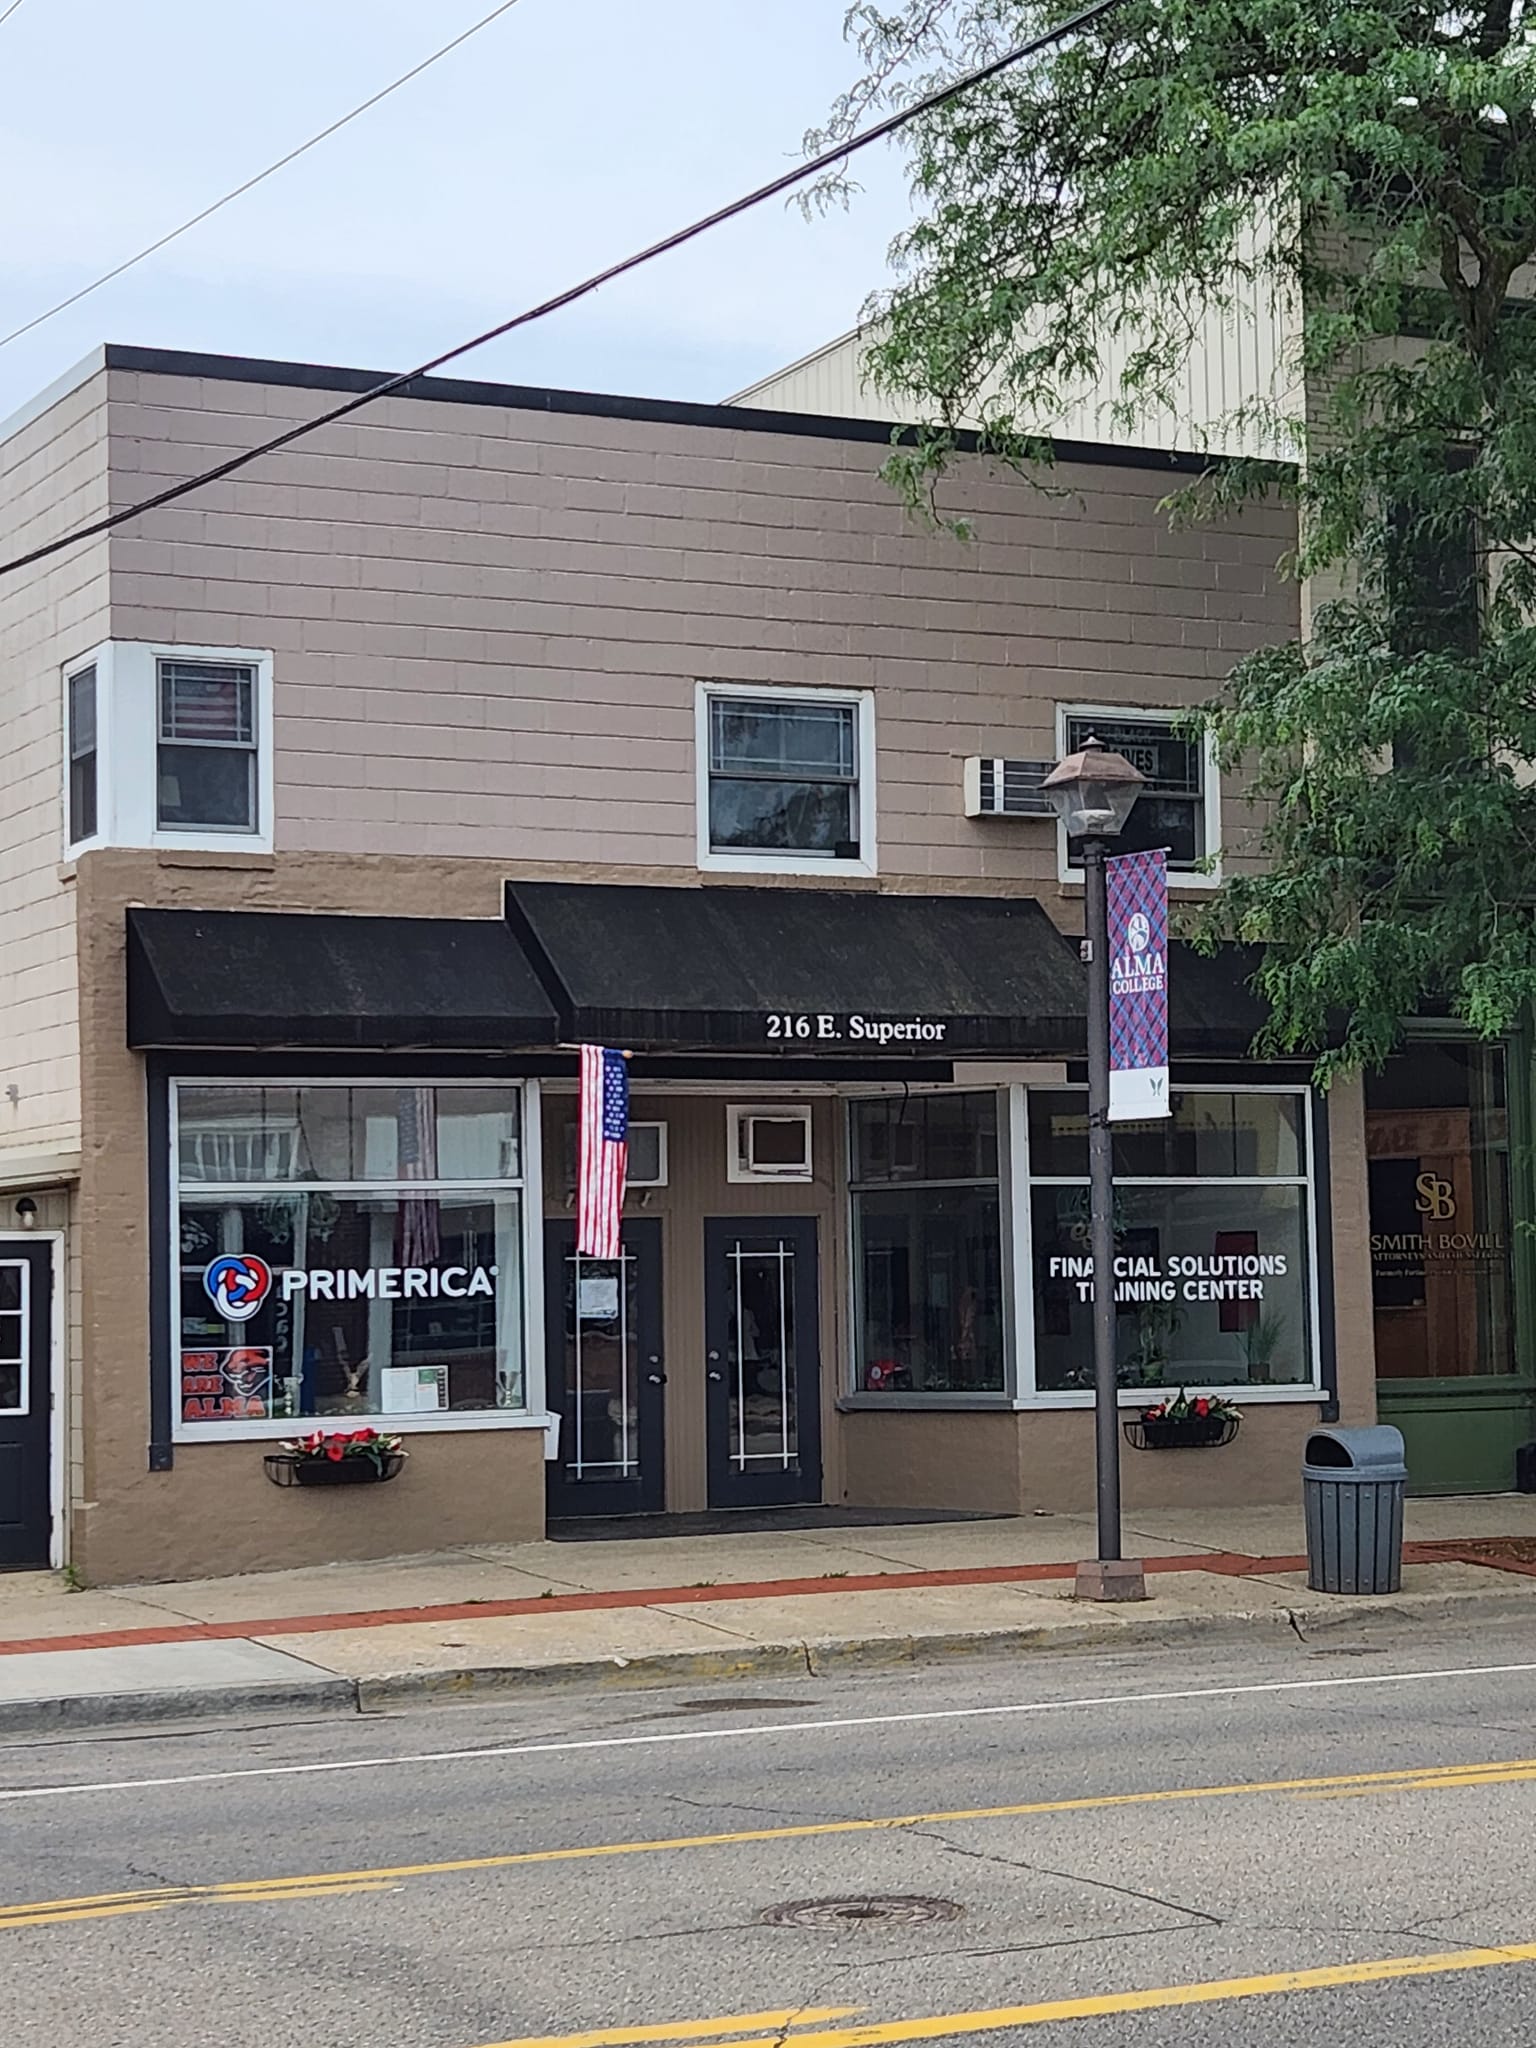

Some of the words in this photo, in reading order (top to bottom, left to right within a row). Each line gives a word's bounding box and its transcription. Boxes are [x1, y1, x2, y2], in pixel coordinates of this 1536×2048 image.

[1111, 952, 1165, 980] ALMA
[1112, 975, 1164, 996] COLLEGE
[766, 1014, 811, 1039] 216
[816, 1014, 842, 1039] E.
[849, 1015, 946, 1045] Superior
[1371, 1234, 1432, 1251] SMITH
[1439, 1233, 1504, 1250] BOVILL
[1049, 1256, 1162, 1278] FINACIAL
[1168, 1255, 1288, 1276] SOLUTIONS
[282, 1266, 494, 1301] PRIMERICA
[1076, 1281, 1176, 1303] TINING
[1183, 1279, 1265, 1301] CENTER
[182, 1352, 218, 1373] WE
[183, 1375, 224, 1396] ARE
[184, 1396, 266, 1420] ALMA
